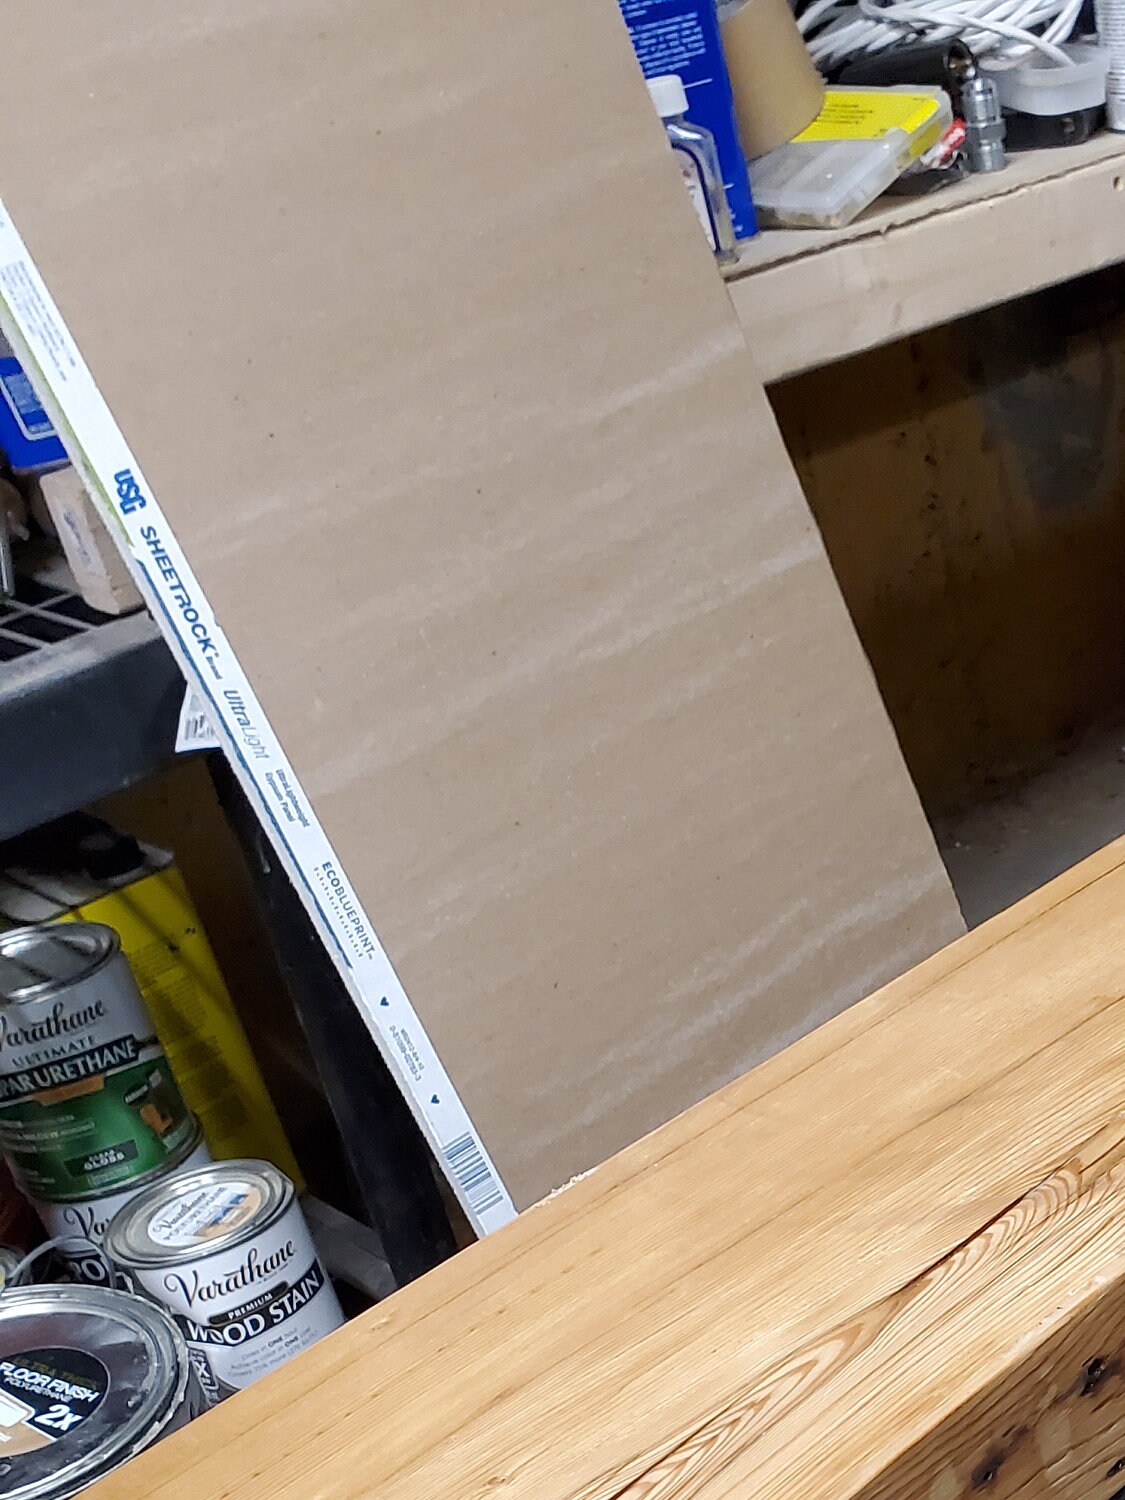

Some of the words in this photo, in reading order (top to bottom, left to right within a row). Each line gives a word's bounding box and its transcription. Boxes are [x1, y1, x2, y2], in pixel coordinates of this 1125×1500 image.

[113, 468, 147, 515] USG
[140, 525, 218, 656] SHEETROCK
[12, 1035, 97, 1068] ULTIMATE
[163, 1239, 297, 1309] Varathane
[186, 1312, 267, 1346] WOOD
[268, 1269, 320, 1324] STAIN
[228, 1292, 274, 1321] PREMIUM
[267, 1335, 284, 1348] ONE
[284, 1335, 299, 1348] ONE
[47, 1378, 101, 1403] FINISH
